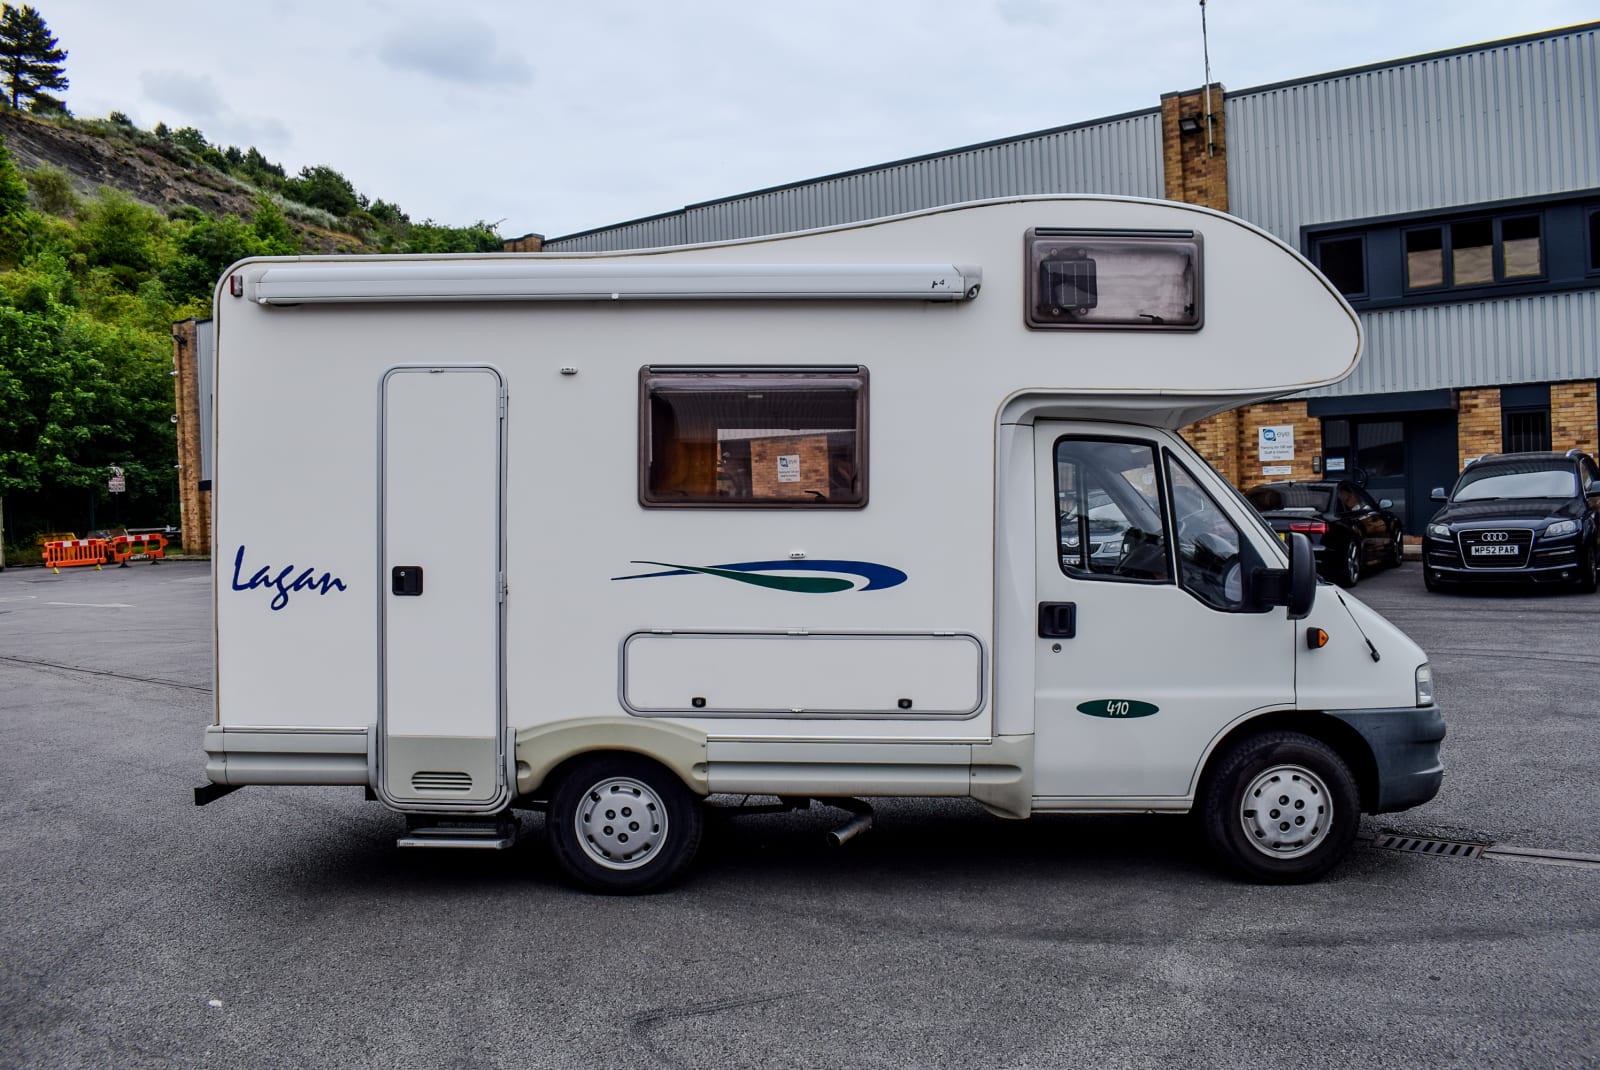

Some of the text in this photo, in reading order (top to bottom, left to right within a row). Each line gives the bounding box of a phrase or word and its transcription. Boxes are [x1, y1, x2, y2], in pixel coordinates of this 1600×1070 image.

[1498, 545, 1515, 553] PAR
[231, 545, 348, 611] Lagan
[1106, 700, 1129, 716] 410
